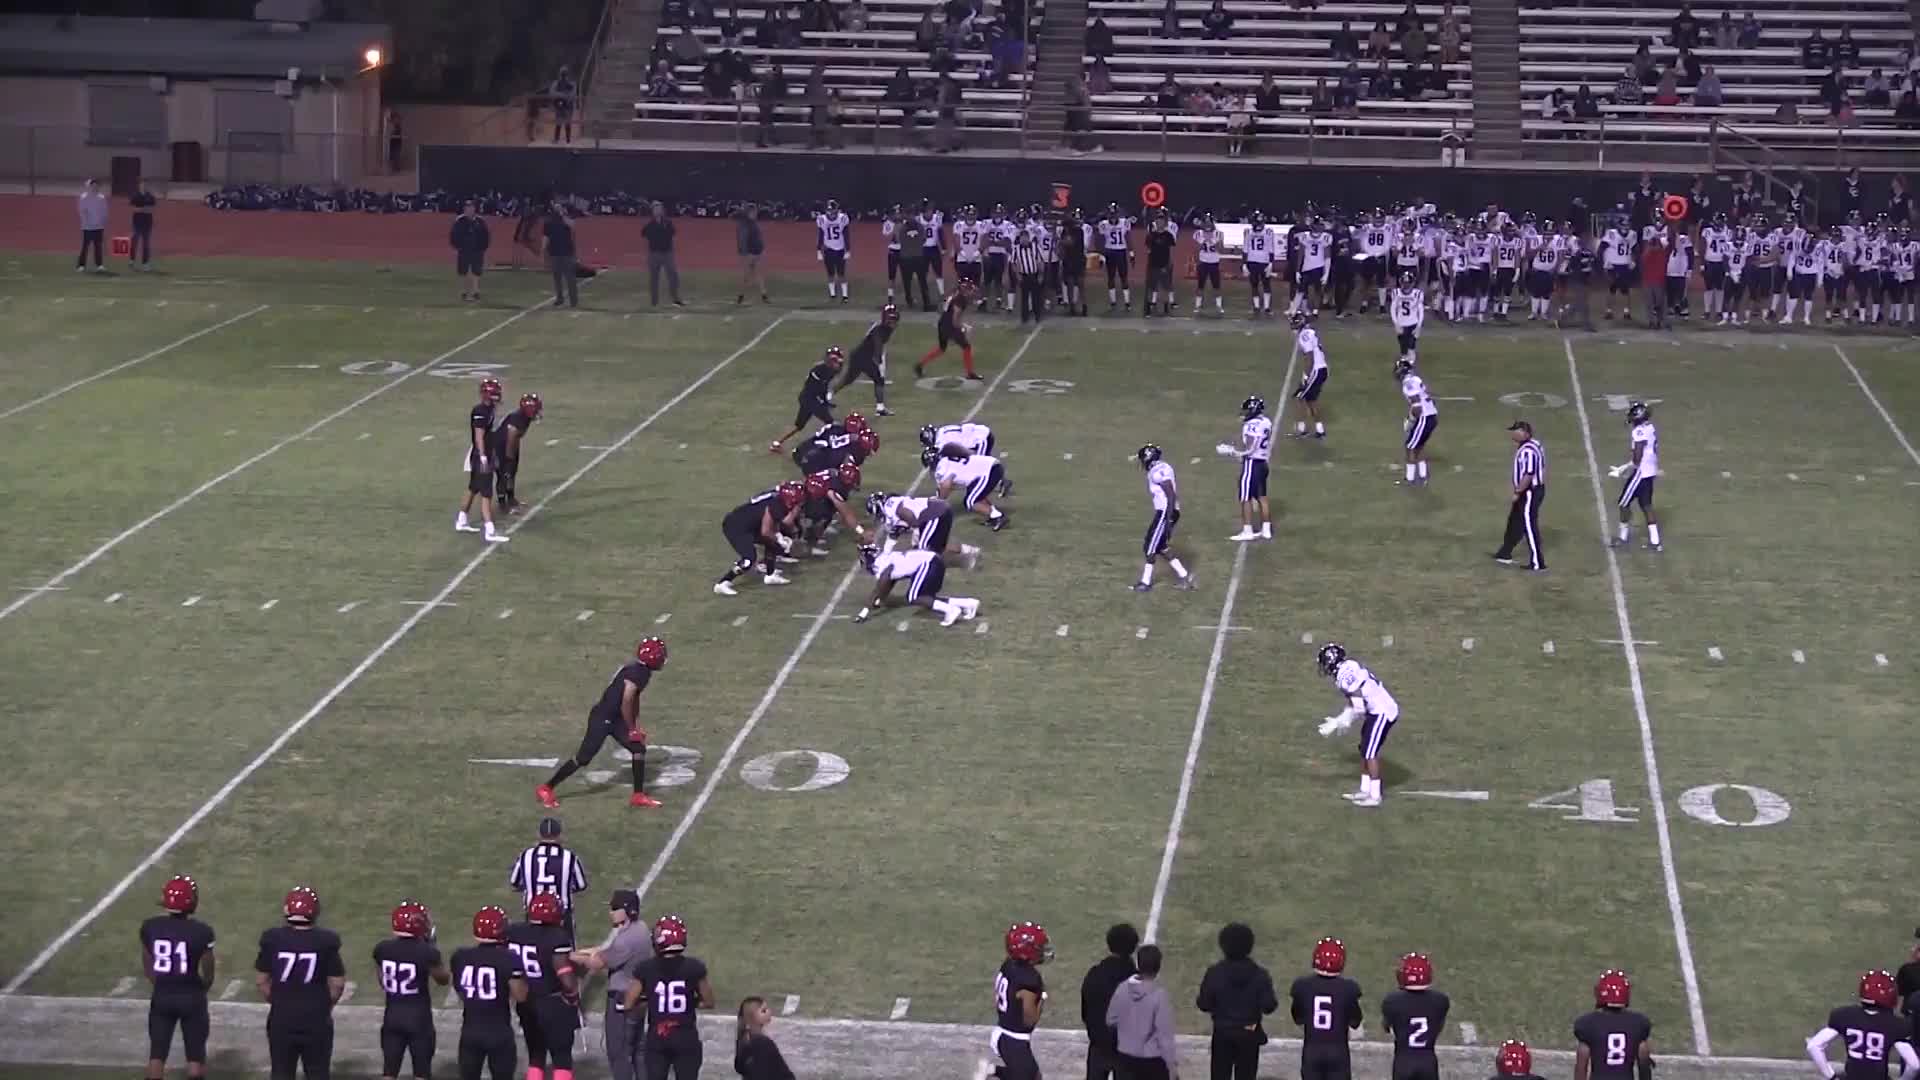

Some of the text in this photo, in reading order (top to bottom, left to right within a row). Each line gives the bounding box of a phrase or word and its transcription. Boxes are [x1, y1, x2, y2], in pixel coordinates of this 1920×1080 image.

[826, 227, 841, 241] 15
[962, 231, 979, 245] 57
[1109, 230, 1124, 244] 51
[1251, 239, 1265, 251] 12
[1310, 244, 1318, 256] 3
[1754, 245, 1770, 257] 85
[1402, 301, 1410, 316] 5
[1527, 778, 1792, 827] 40
[537, 858, 555, 883] L
[153, 939, 188, 974] 81
[277, 952, 318, 984] 77
[381, 960, 419, 995] 82
[460, 965, 497, 1000] 40
[654, 980, 687, 1014] 16
[1313, 996, 1332, 1030] 6
[1408, 1017, 1428, 1048] 2
[1845, 1028, 1884, 1061] 28
[1607, 1033, 1626, 1065] 8
